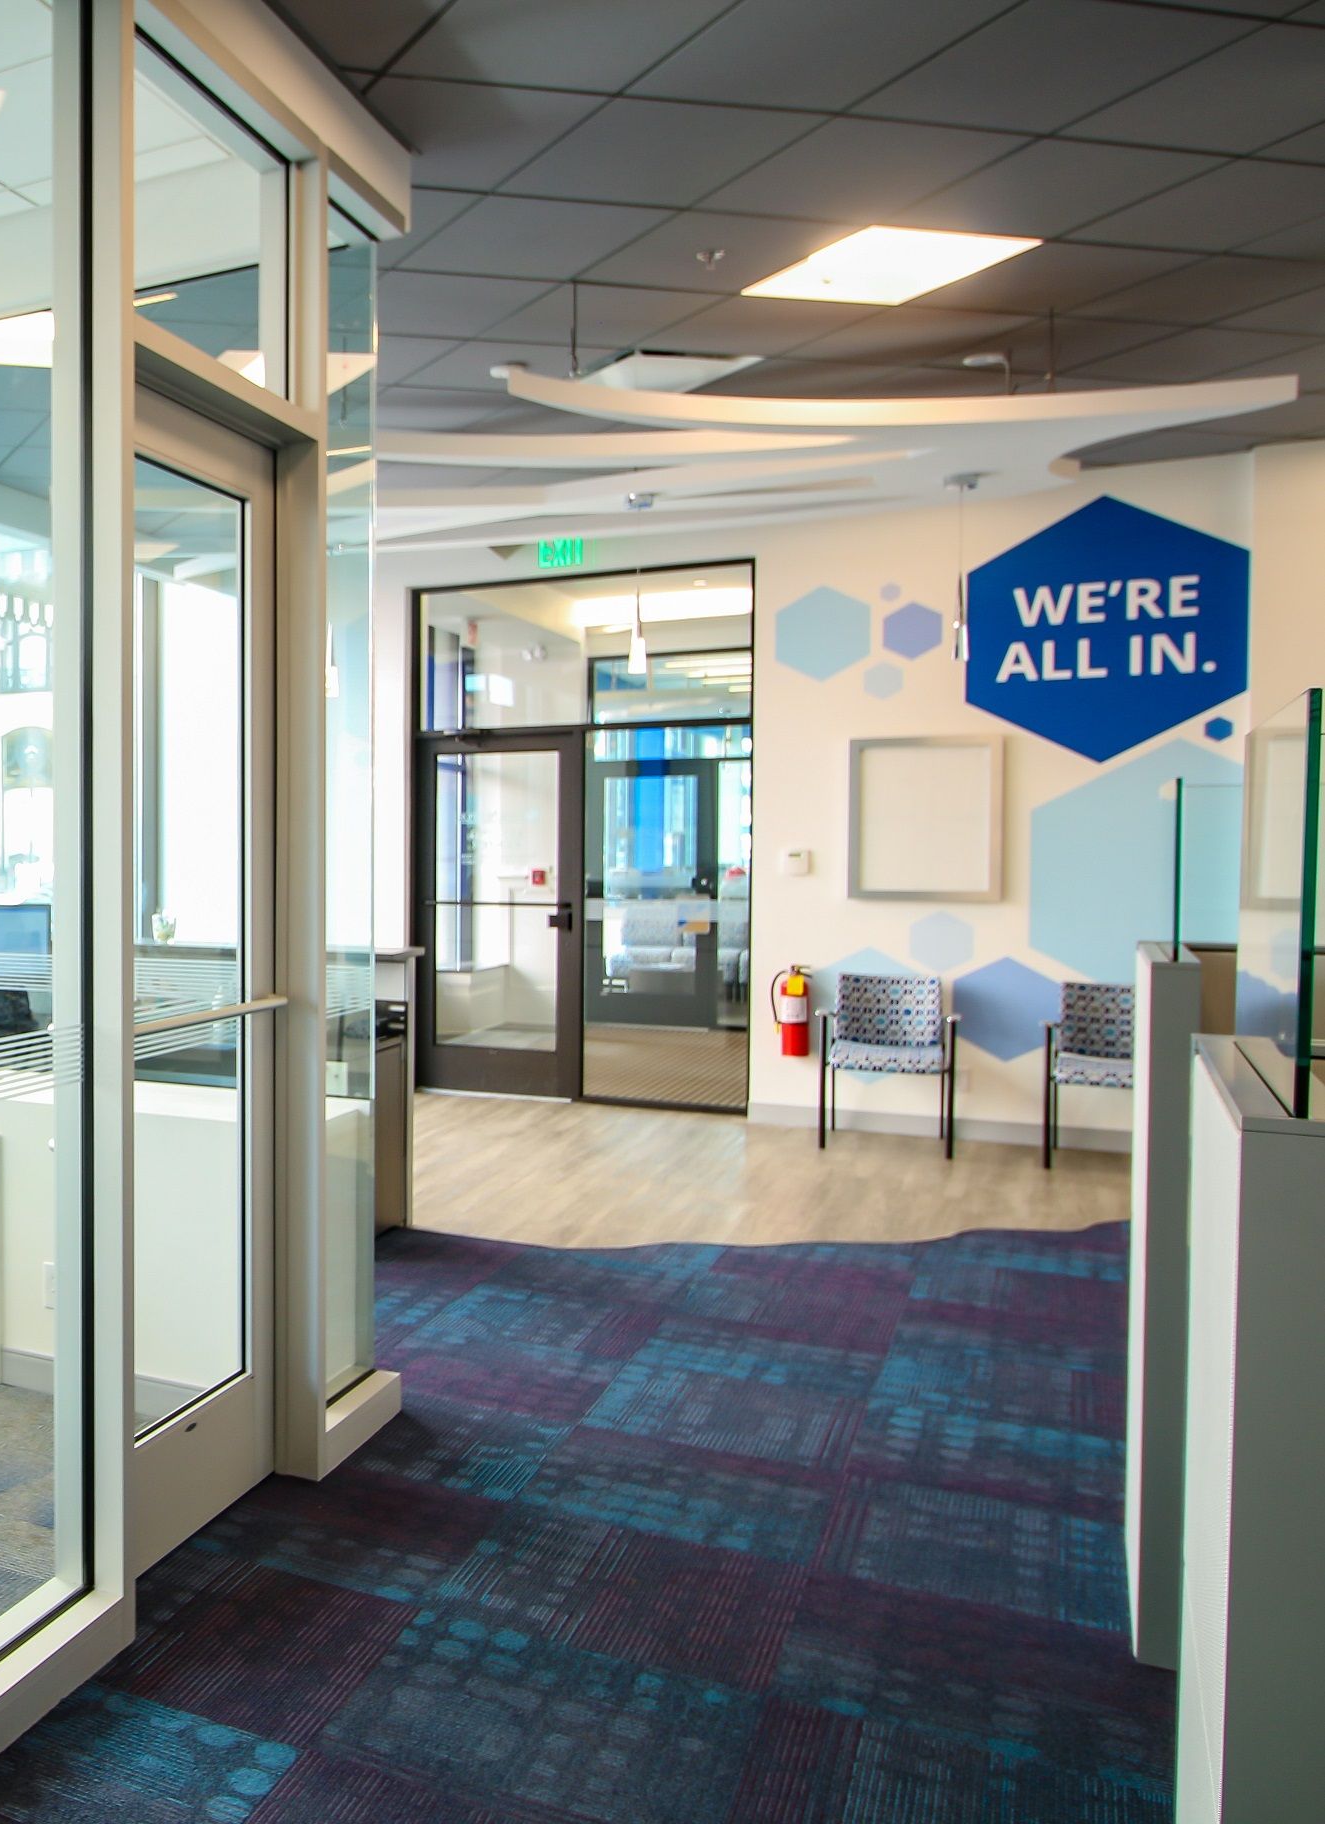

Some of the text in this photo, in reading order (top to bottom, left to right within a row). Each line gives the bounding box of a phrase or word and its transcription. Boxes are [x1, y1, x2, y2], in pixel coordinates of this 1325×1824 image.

[1013, 574, 1201, 628] WE'RE
[995, 631, 1217, 684] ALL IN.
